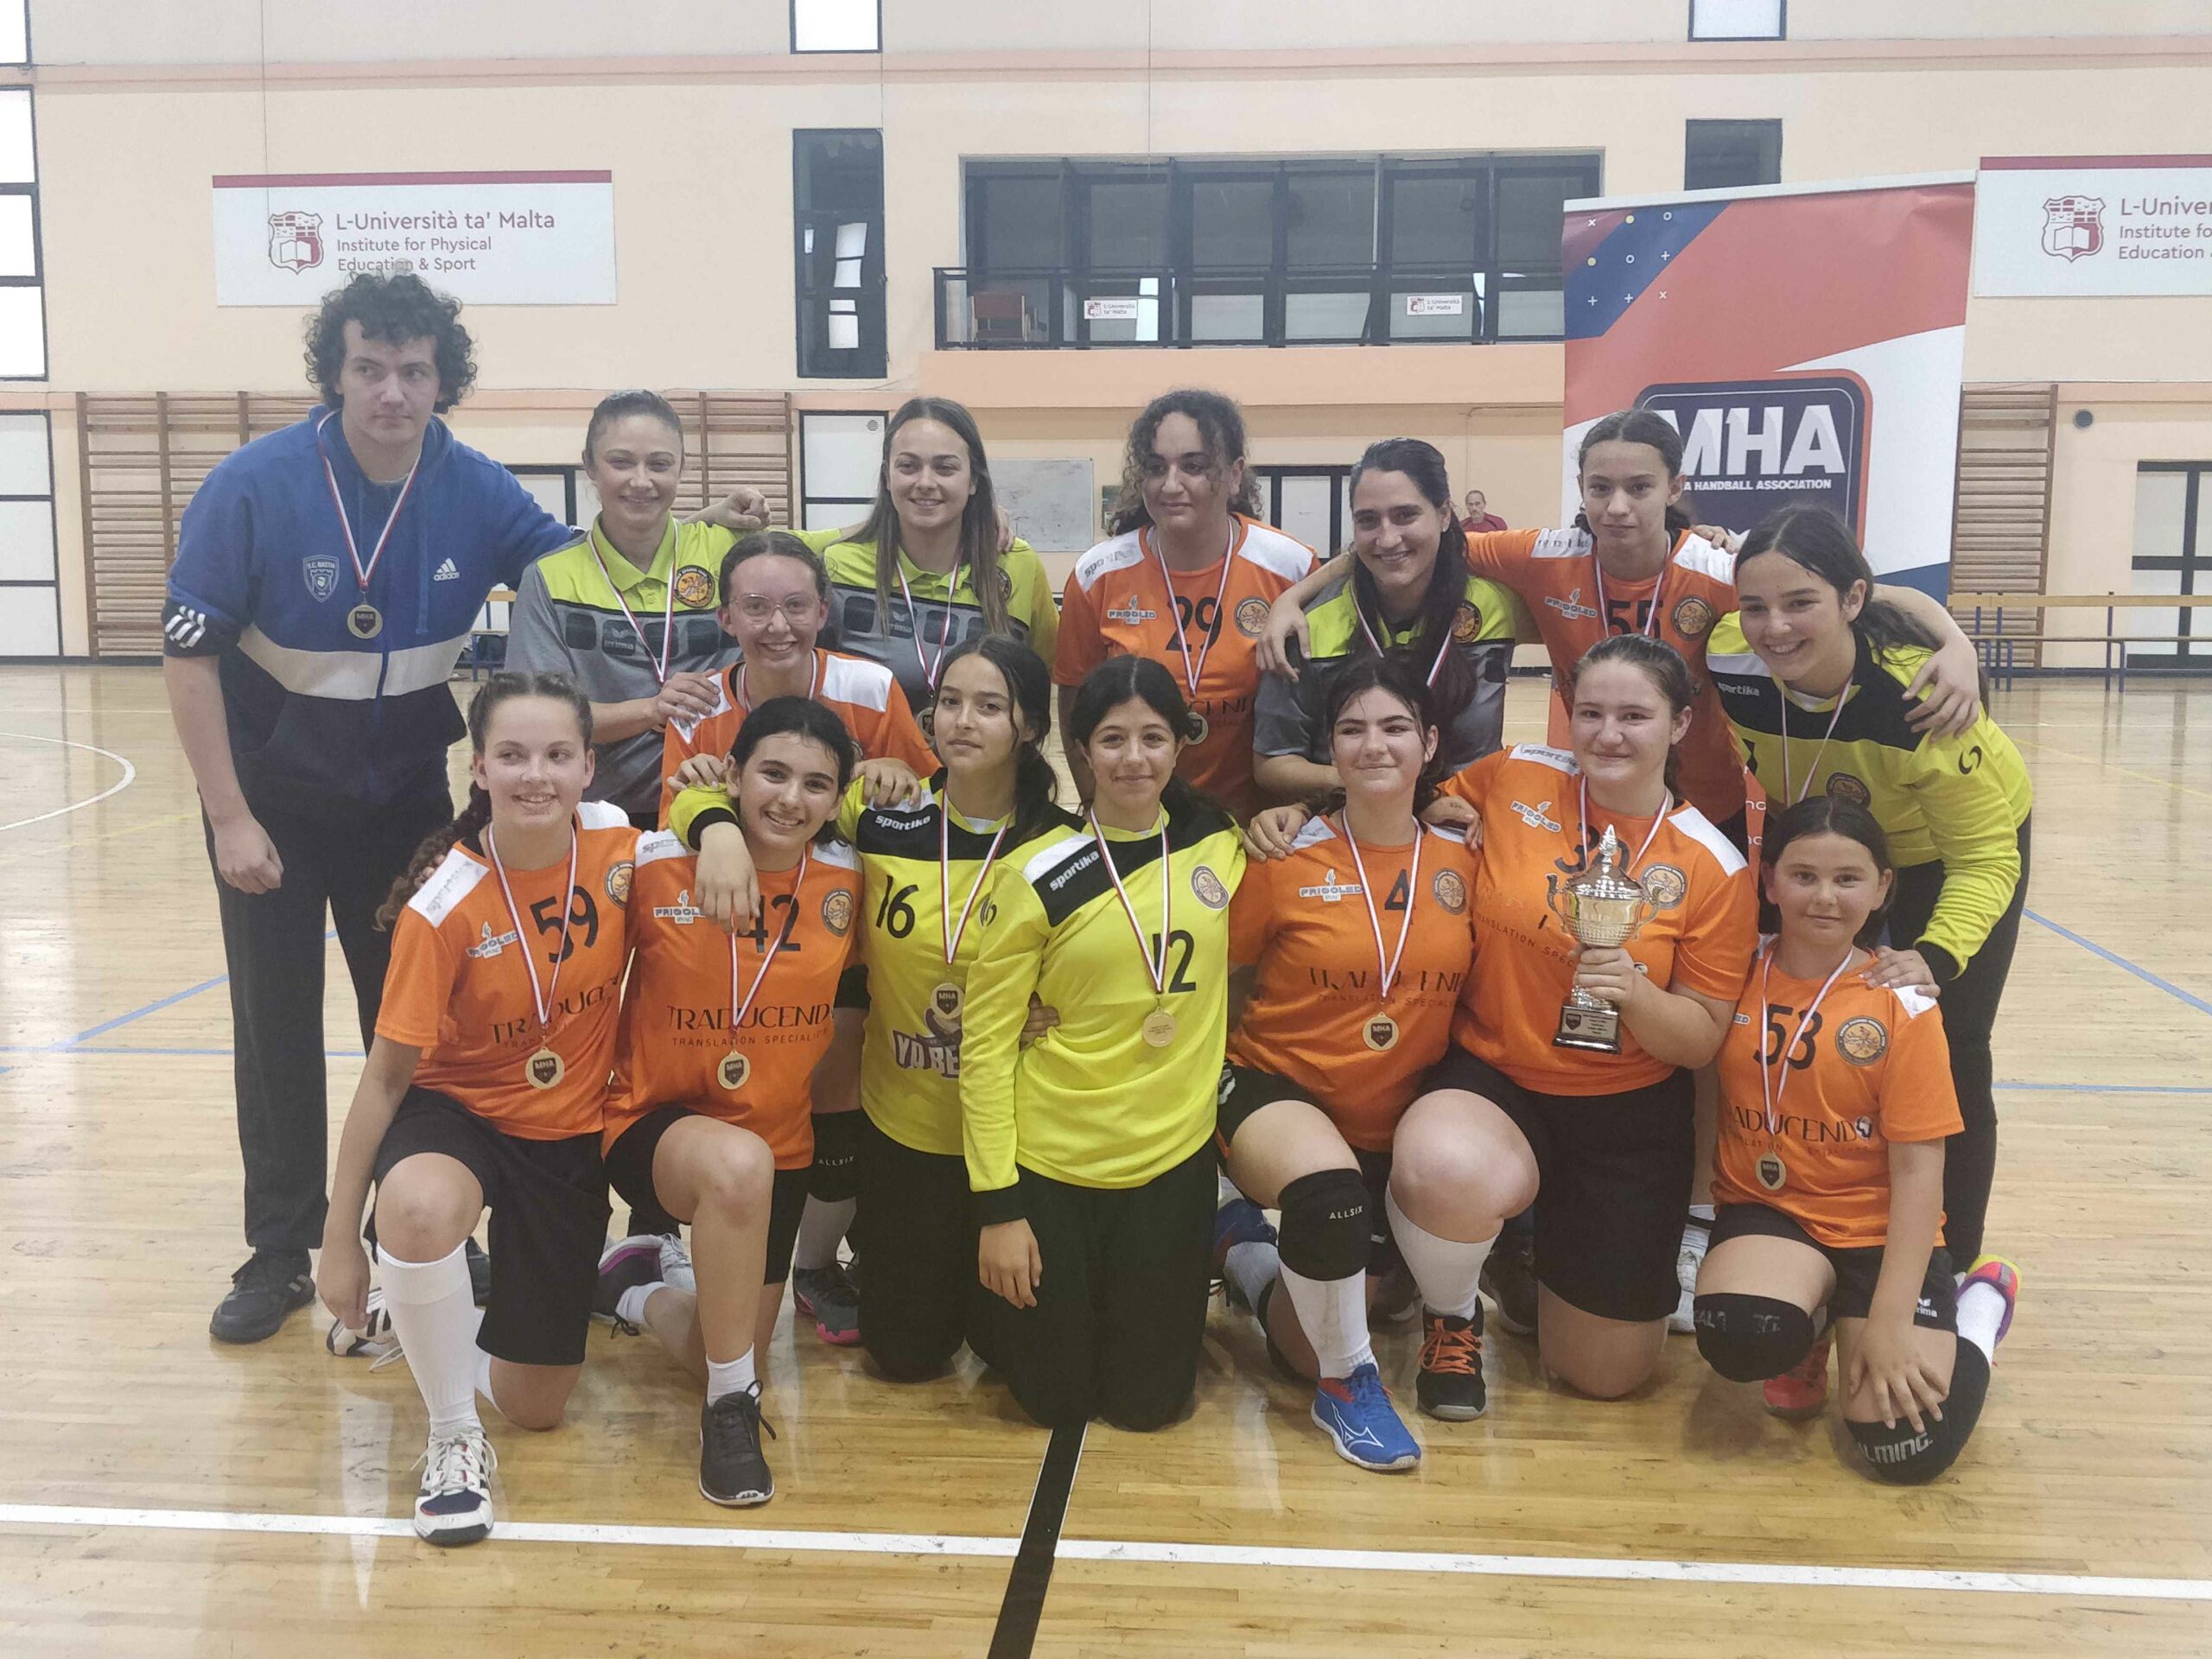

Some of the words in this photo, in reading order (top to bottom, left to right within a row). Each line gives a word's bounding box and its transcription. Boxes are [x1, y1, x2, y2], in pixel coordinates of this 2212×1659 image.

[336, 211, 458, 231] L-Università
[465, 212, 491, 230] ta'
[499, 211, 556, 229] Malta
[2120, 225, 2191, 239] Institute
[336, 237, 400, 252] Institute
[404, 236, 426, 251] for
[430, 235, 493, 254] Physical
[2119, 245, 2204, 260] Education
[338, 257, 414, 272] Education
[418, 257, 429, 271] &
[434, 257, 476, 274] Sport
[1654, 404, 1846, 476] MHA
[1694, 480, 1753, 492] HANDBALL
[1755, 478, 1832, 491] ASSOCIATION
[434, 571, 461, 582] adidas
[889, 622, 912, 633] rima
[1166, 595, 1224, 652] 29
[874, 815, 931, 830] sportika
[1049, 850, 1100, 891] sportika
[654, 908, 700, 917] FRIGOL
[875, 874, 919, 939] 16
[530, 885, 600, 963] 59
[736, 893, 802, 954] 42
[1153, 930, 1197, 994] 12
[666, 1002, 834, 1031] TRADUCEND
[1752, 1002, 1823, 1070] 53
[1328, 1205, 1363, 1220] ALLSIX
